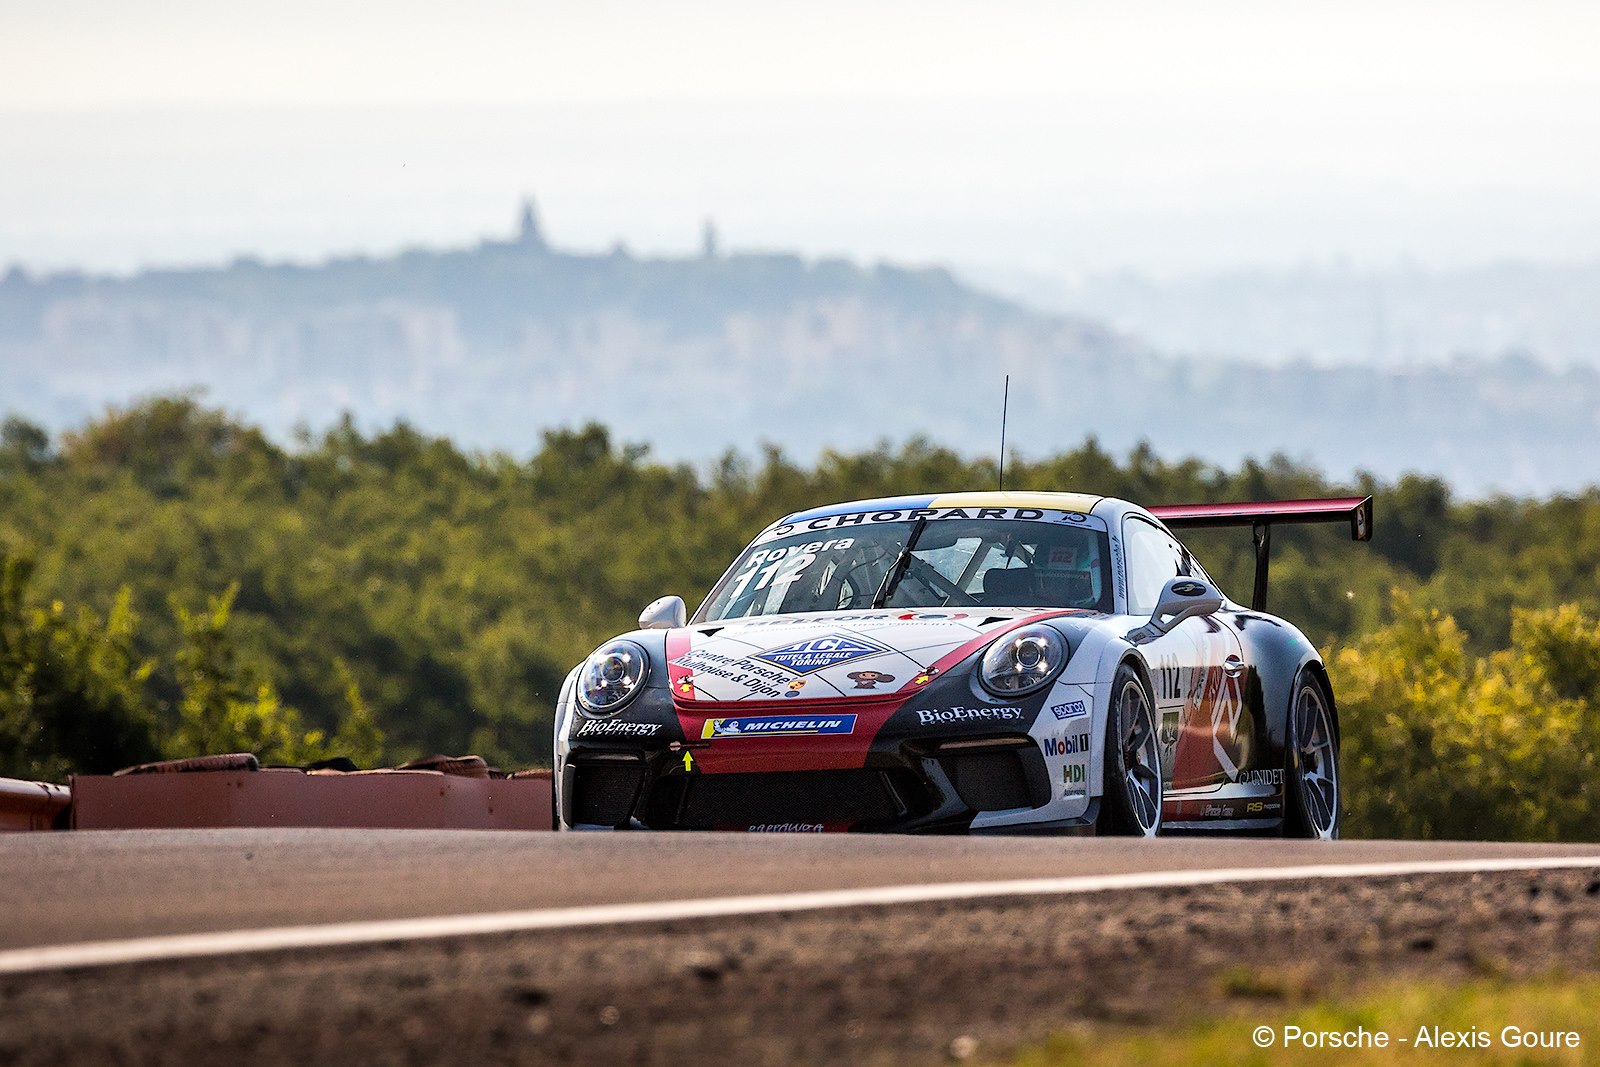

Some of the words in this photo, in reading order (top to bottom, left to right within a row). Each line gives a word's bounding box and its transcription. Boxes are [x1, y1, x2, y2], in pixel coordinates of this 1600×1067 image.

[807, 507, 1044, 530] CHOPARD
[744, 538, 856, 569] Rovera
[729, 552, 817, 600] 112
[774, 652, 811, 662] TUTELA
[813, 651, 854, 660] LEGALE
[790, 659, 831, 667] TORINO
[731, 659, 790, 685] Porsche
[731, 673, 749, 684] &
[742, 678, 781, 698] Dijon
[915, 706, 1023, 723] BioEnergy
[576, 719, 663, 737] BioEnergy
[743, 719, 842, 732] MICHELIN
[1044, 735, 1078, 757] Mobil
[1063, 764, 1085, 783] HDI
[1247, 801, 1264, 812] RS
